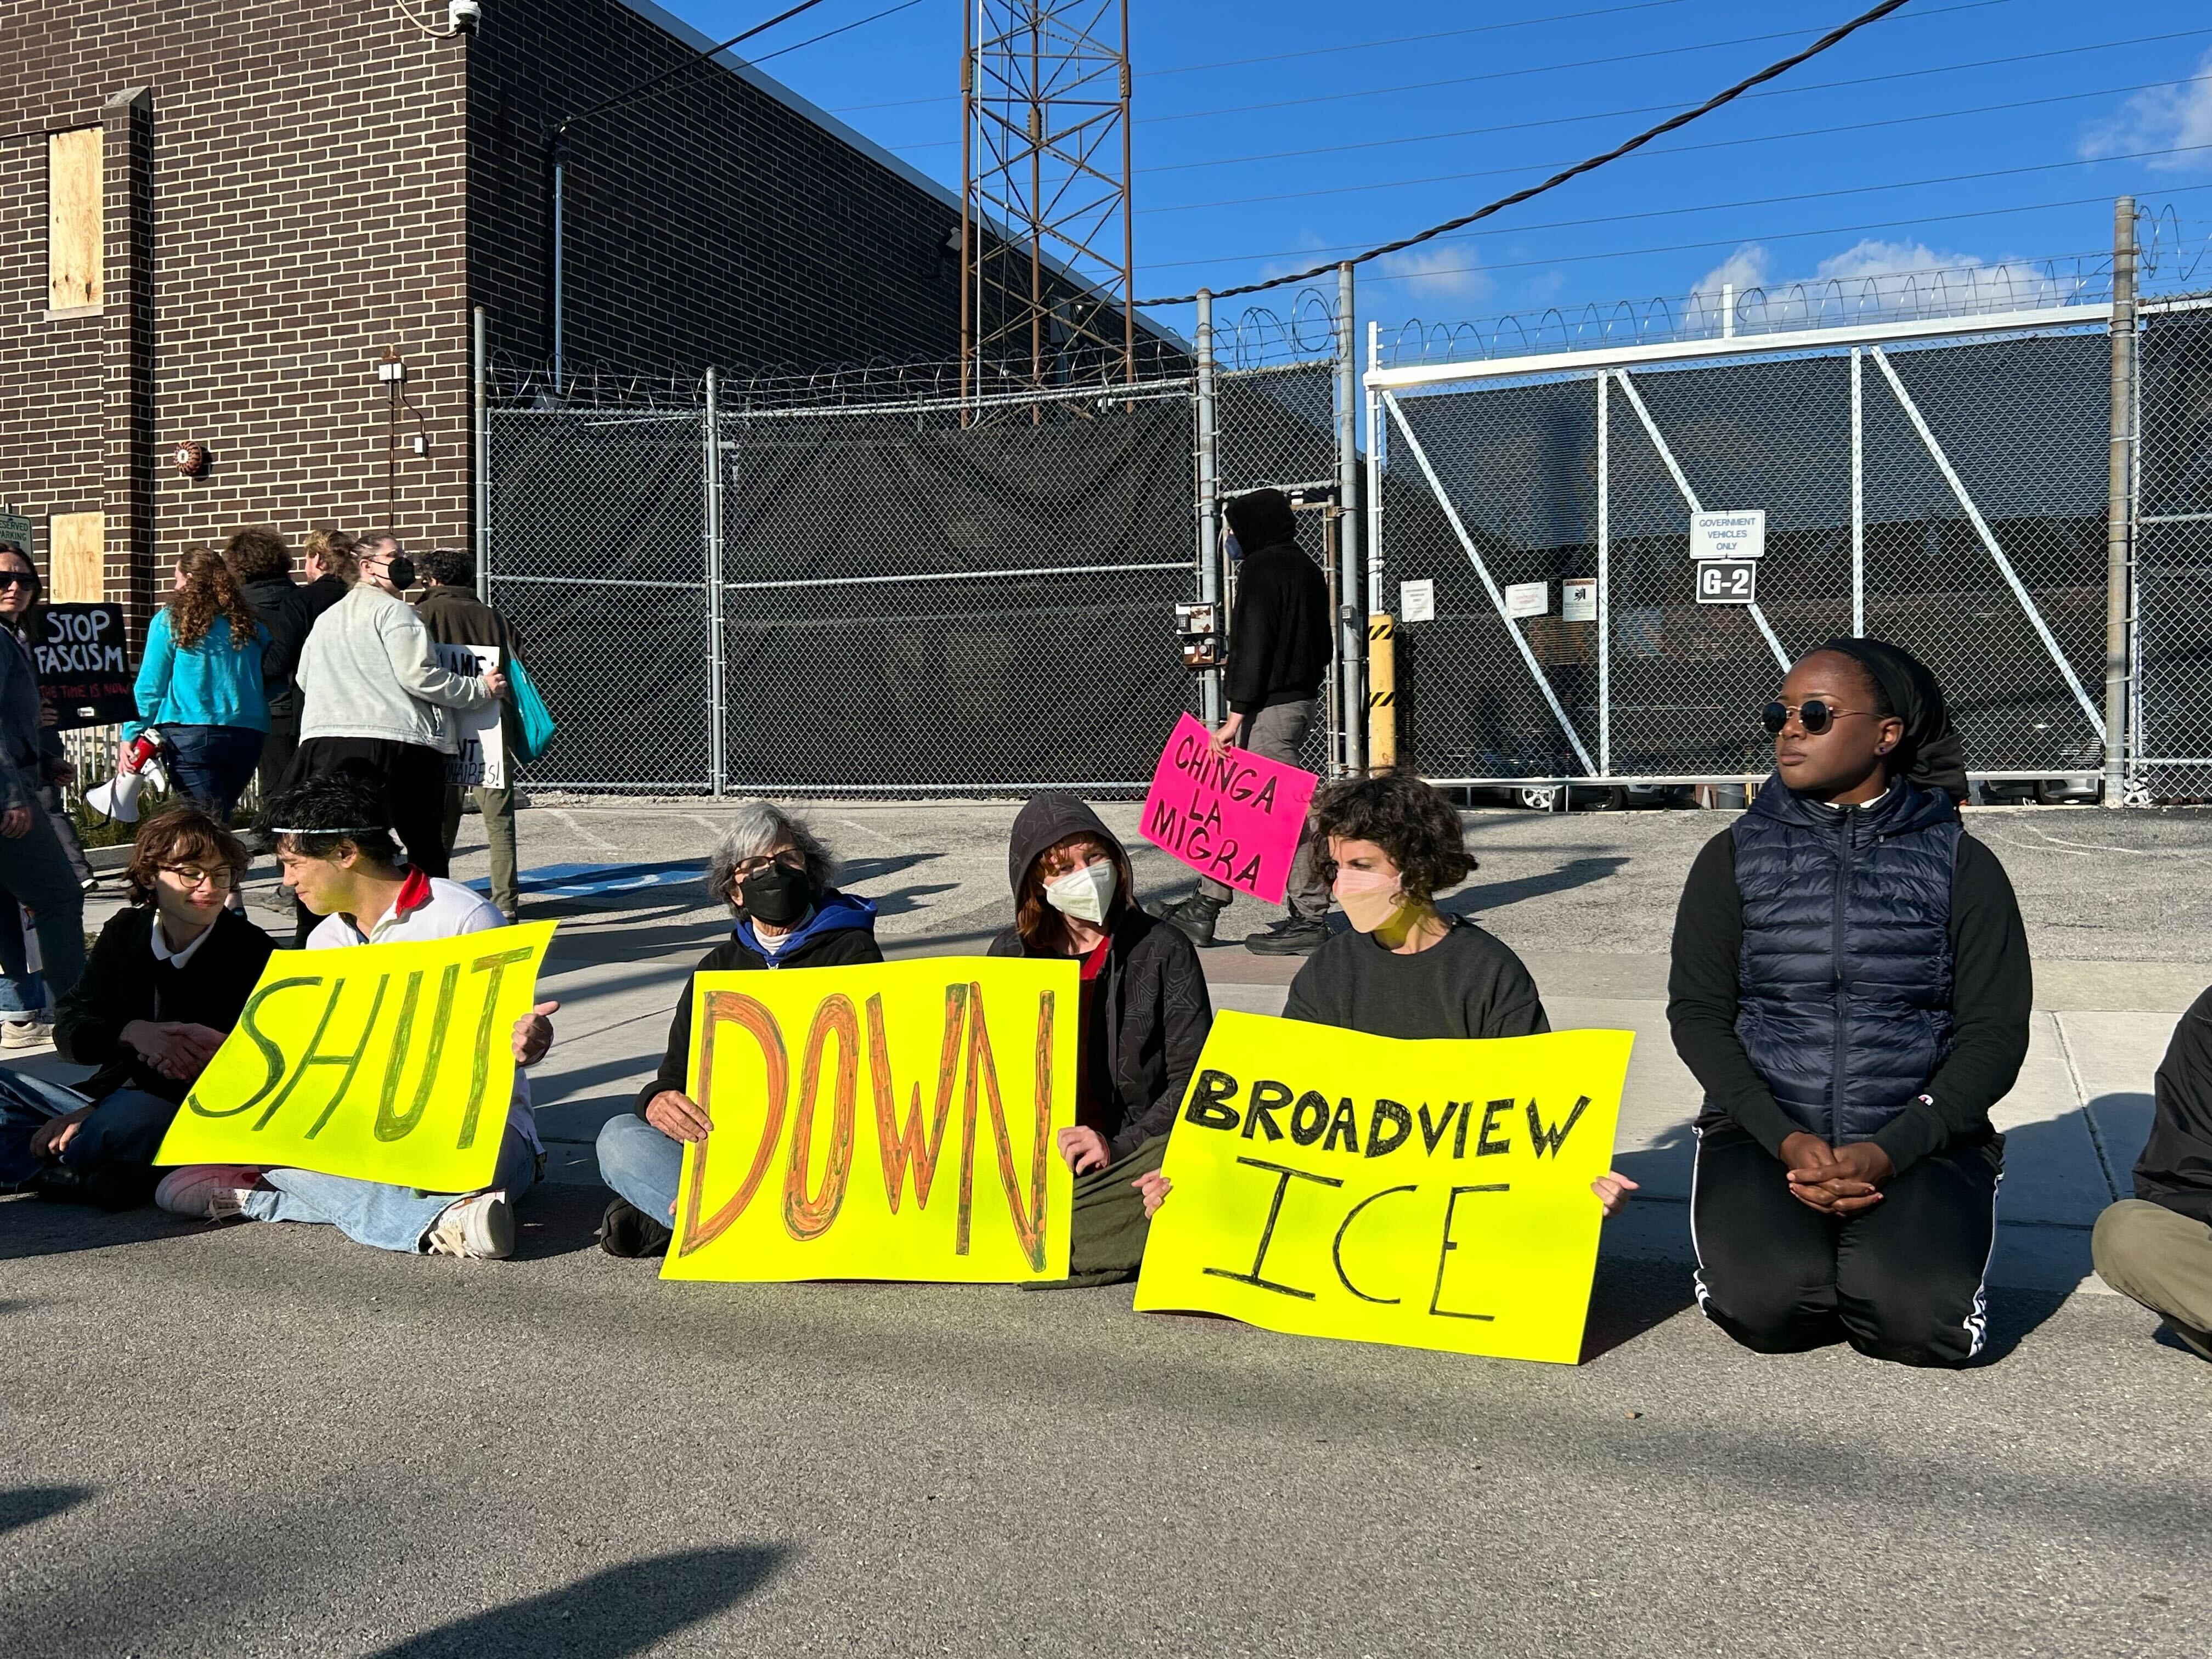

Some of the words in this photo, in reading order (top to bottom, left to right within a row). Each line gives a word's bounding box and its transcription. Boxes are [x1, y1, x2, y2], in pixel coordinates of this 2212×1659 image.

[1699, 518, 1756, 527] GOVERNMENT
[1708, 530, 1747, 538] VEHICLES
[1716, 542, 1737, 550] ONLY
[1703, 569, 1749, 594] G-2
[47, 610, 110, 643] STOP
[34, 643, 123, 674] FASCISM
[38, 685, 57, 698] THE
[58, 685, 88, 698] TIME
[89, 682, 101, 697] IS
[103, 682, 130, 695] NOW
[1176, 735, 1277, 815] CHINGA
[1189, 788, 1221, 836] LA
[1151, 798, 1261, 891] MIGRA
[188, 946, 534, 1149] SHUT
[678, 981, 1054, 1273] DOWN
[1184, 1069, 1592, 1161] BROADVIEW
[1202, 1155, 1510, 1322] ICE
